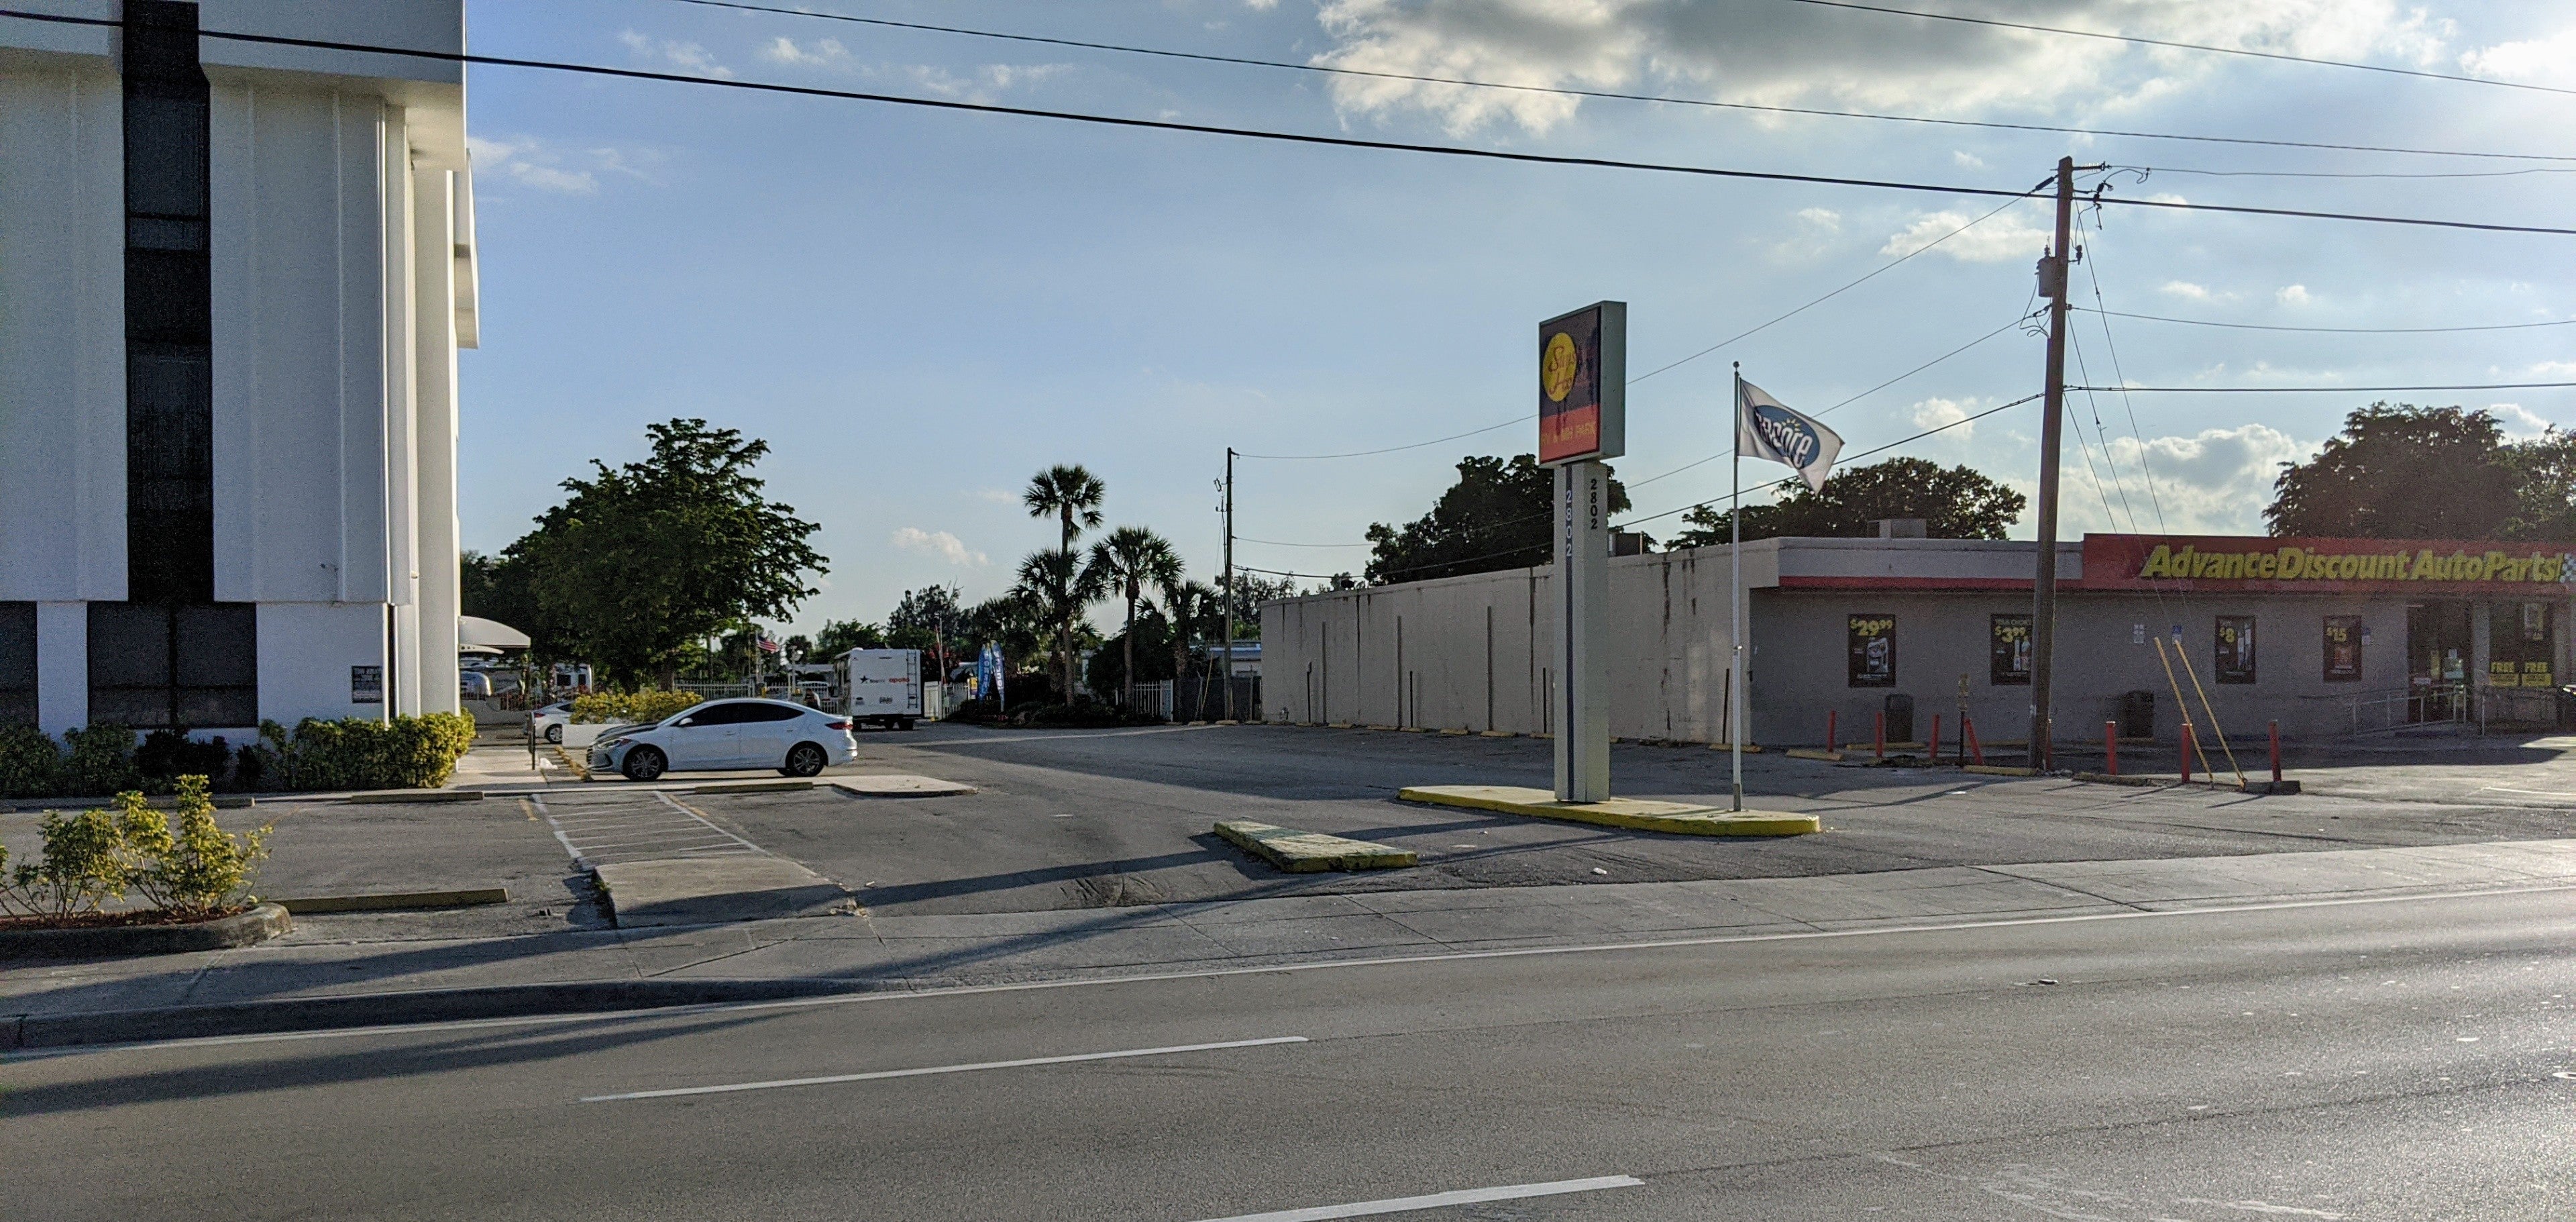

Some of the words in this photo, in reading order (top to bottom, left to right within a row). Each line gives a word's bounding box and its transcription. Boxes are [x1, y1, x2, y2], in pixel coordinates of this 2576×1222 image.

[2141, 544, 2276, 578] Advance
[2277, 546, 2412, 580] Discount
[2413, 549, 2482, 581] Auto
[2219, 627, 2235, 643] $8
[2491, 662, 2515, 672] FREE
[2524, 662, 2548, 672] FREE
